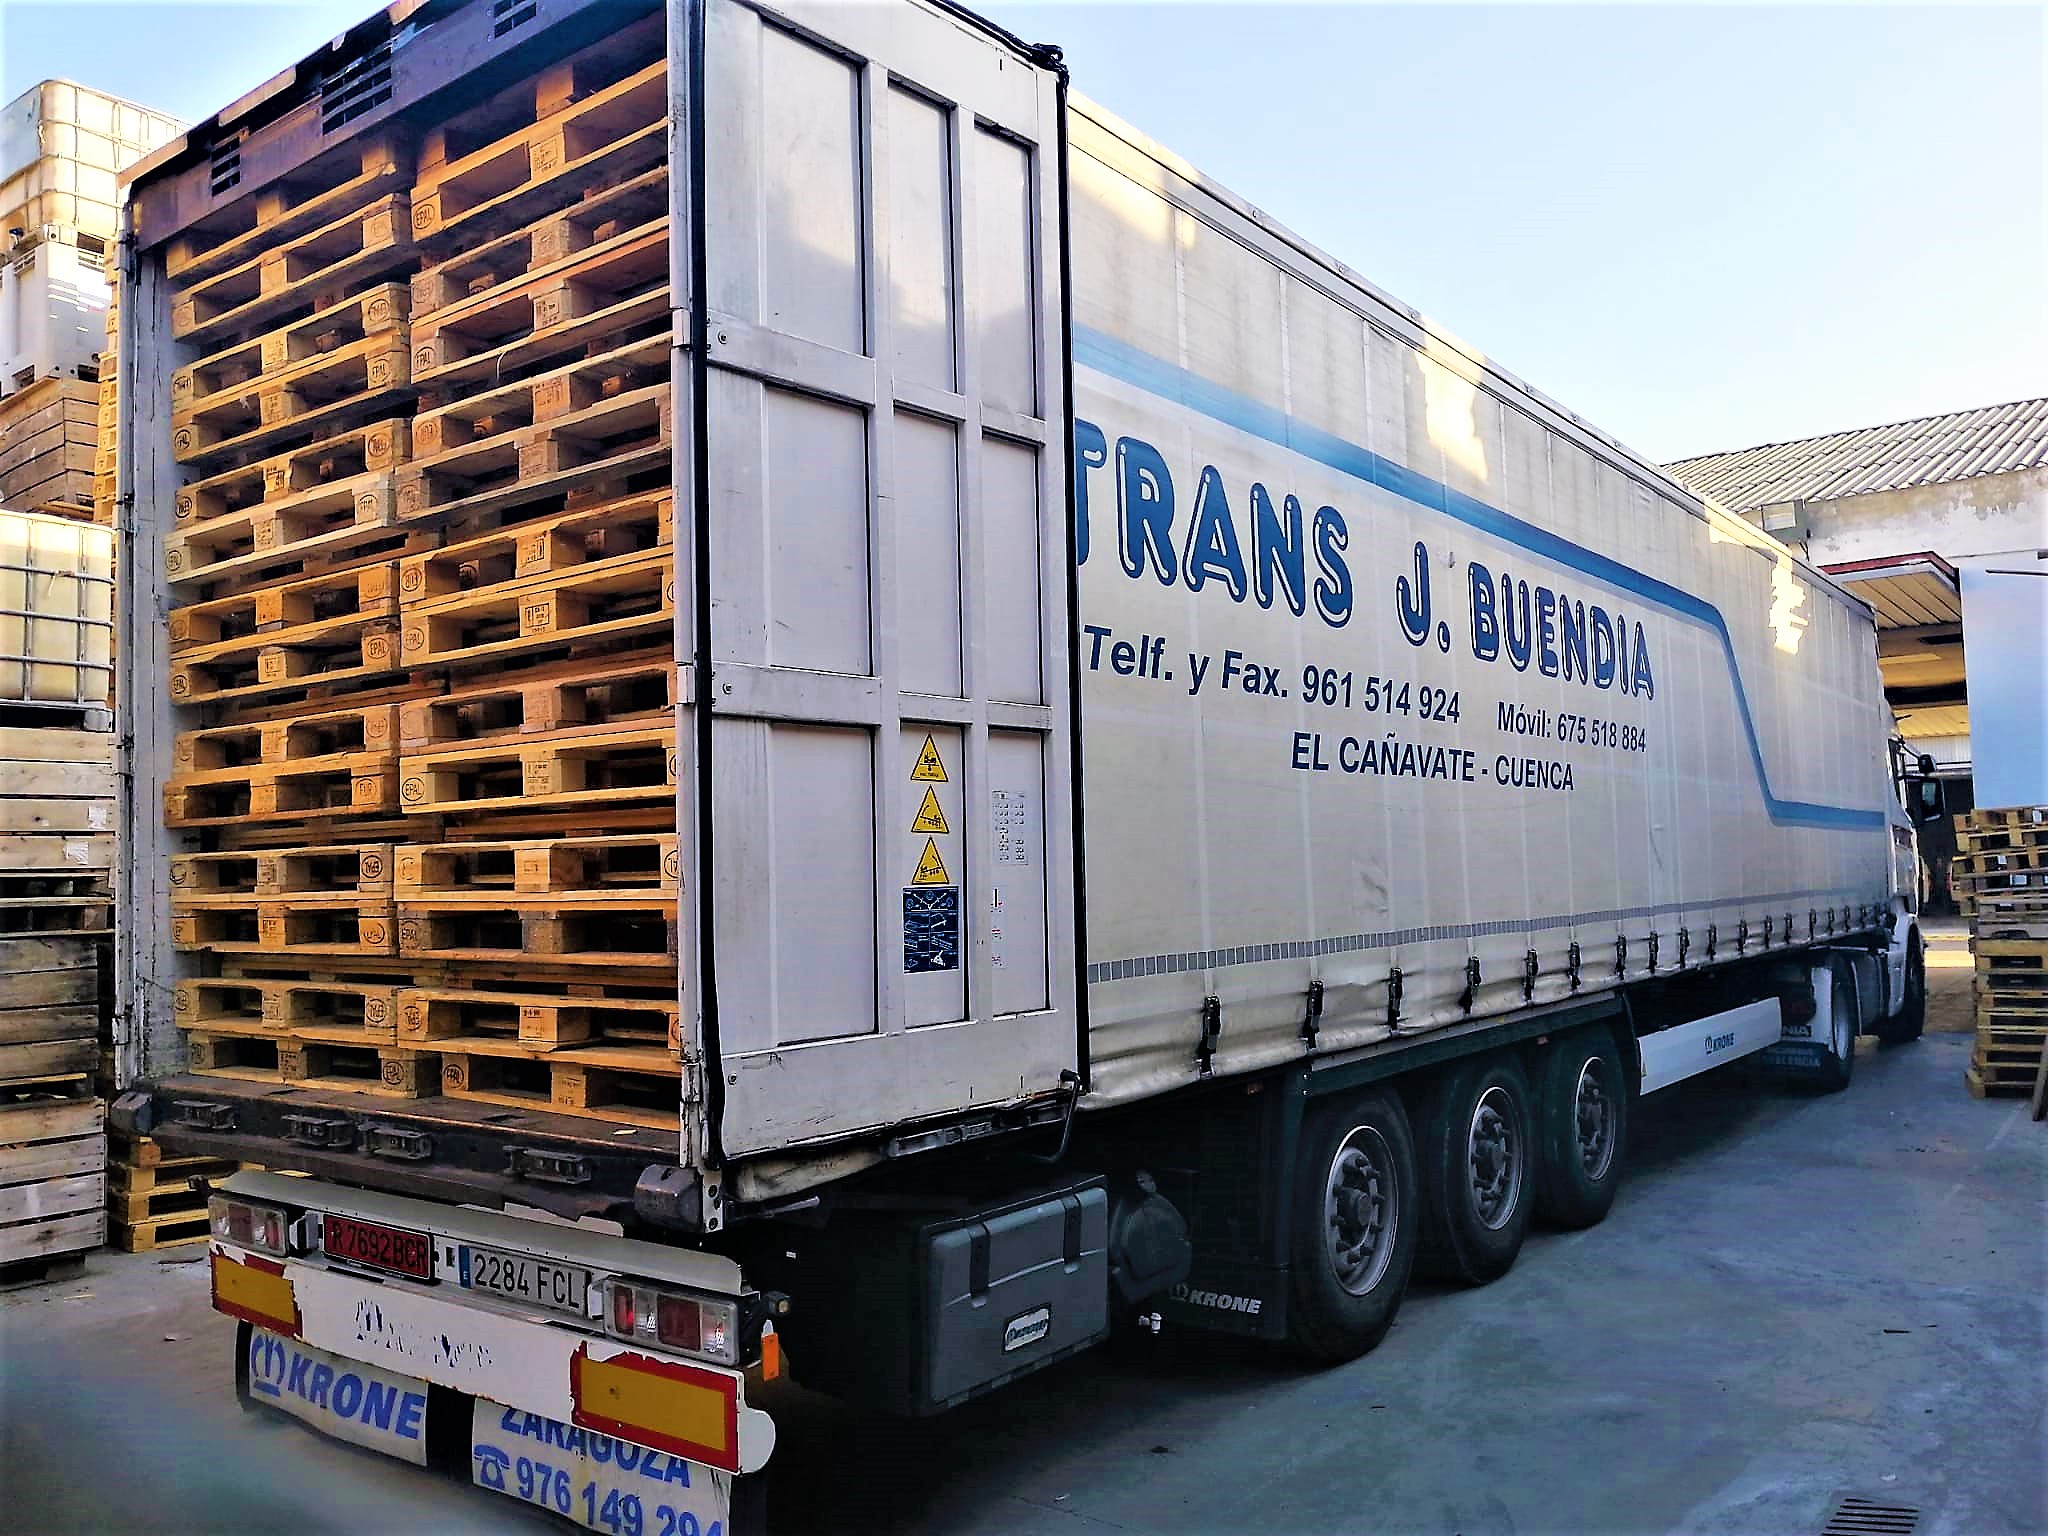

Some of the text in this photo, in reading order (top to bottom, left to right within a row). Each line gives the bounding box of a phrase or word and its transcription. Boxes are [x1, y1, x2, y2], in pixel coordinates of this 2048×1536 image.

[1396, 541, 1451, 654] J.
[1468, 561, 1655, 701] BUENDIA
[369, 643, 386, 659] EPAL
[1084, 624, 1460, 724] Telf. y Fax. 961 514 924
[1498, 701, 1647, 753] Móvil: 675 518 884
[405, 782, 421, 796] EPAL
[1292, 732, 1329, 771] EL
[1339, 731, 1475, 782] CAÑAVATE
[1495, 755, 1574, 791] CUENCA
[1712, 1032, 1735, 1052] KRONE
[474, 1253, 530, 1296] 2284
[537, 1265, 580, 1309] FCL
[1191, 1289, 1262, 1315] KRONE
[287, 1351, 427, 1440] KRONE
[516, 1456, 572, 1514] 976
[581, 1481, 643, 1536] 149
